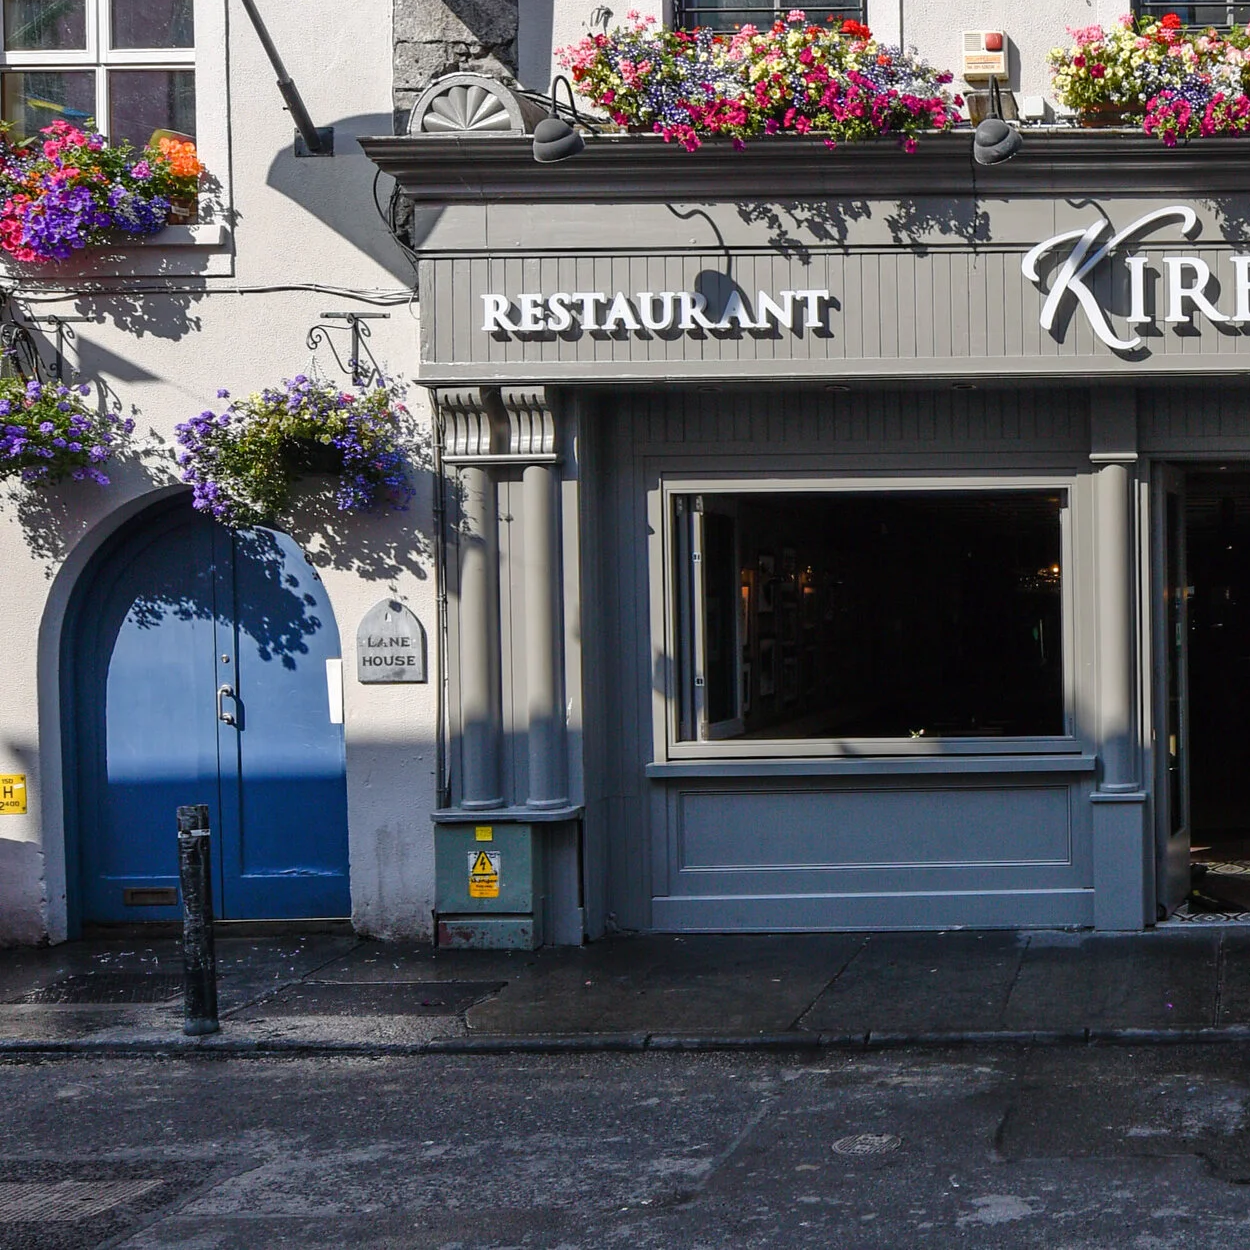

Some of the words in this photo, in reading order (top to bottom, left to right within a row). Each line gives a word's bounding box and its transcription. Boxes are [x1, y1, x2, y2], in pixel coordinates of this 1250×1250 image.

[480, 289, 829, 332] RESTAURANT
[368, 635, 411, 647] LANE
[362, 656, 416, 666] HOUSE
[3, 785, 13, 798] H
